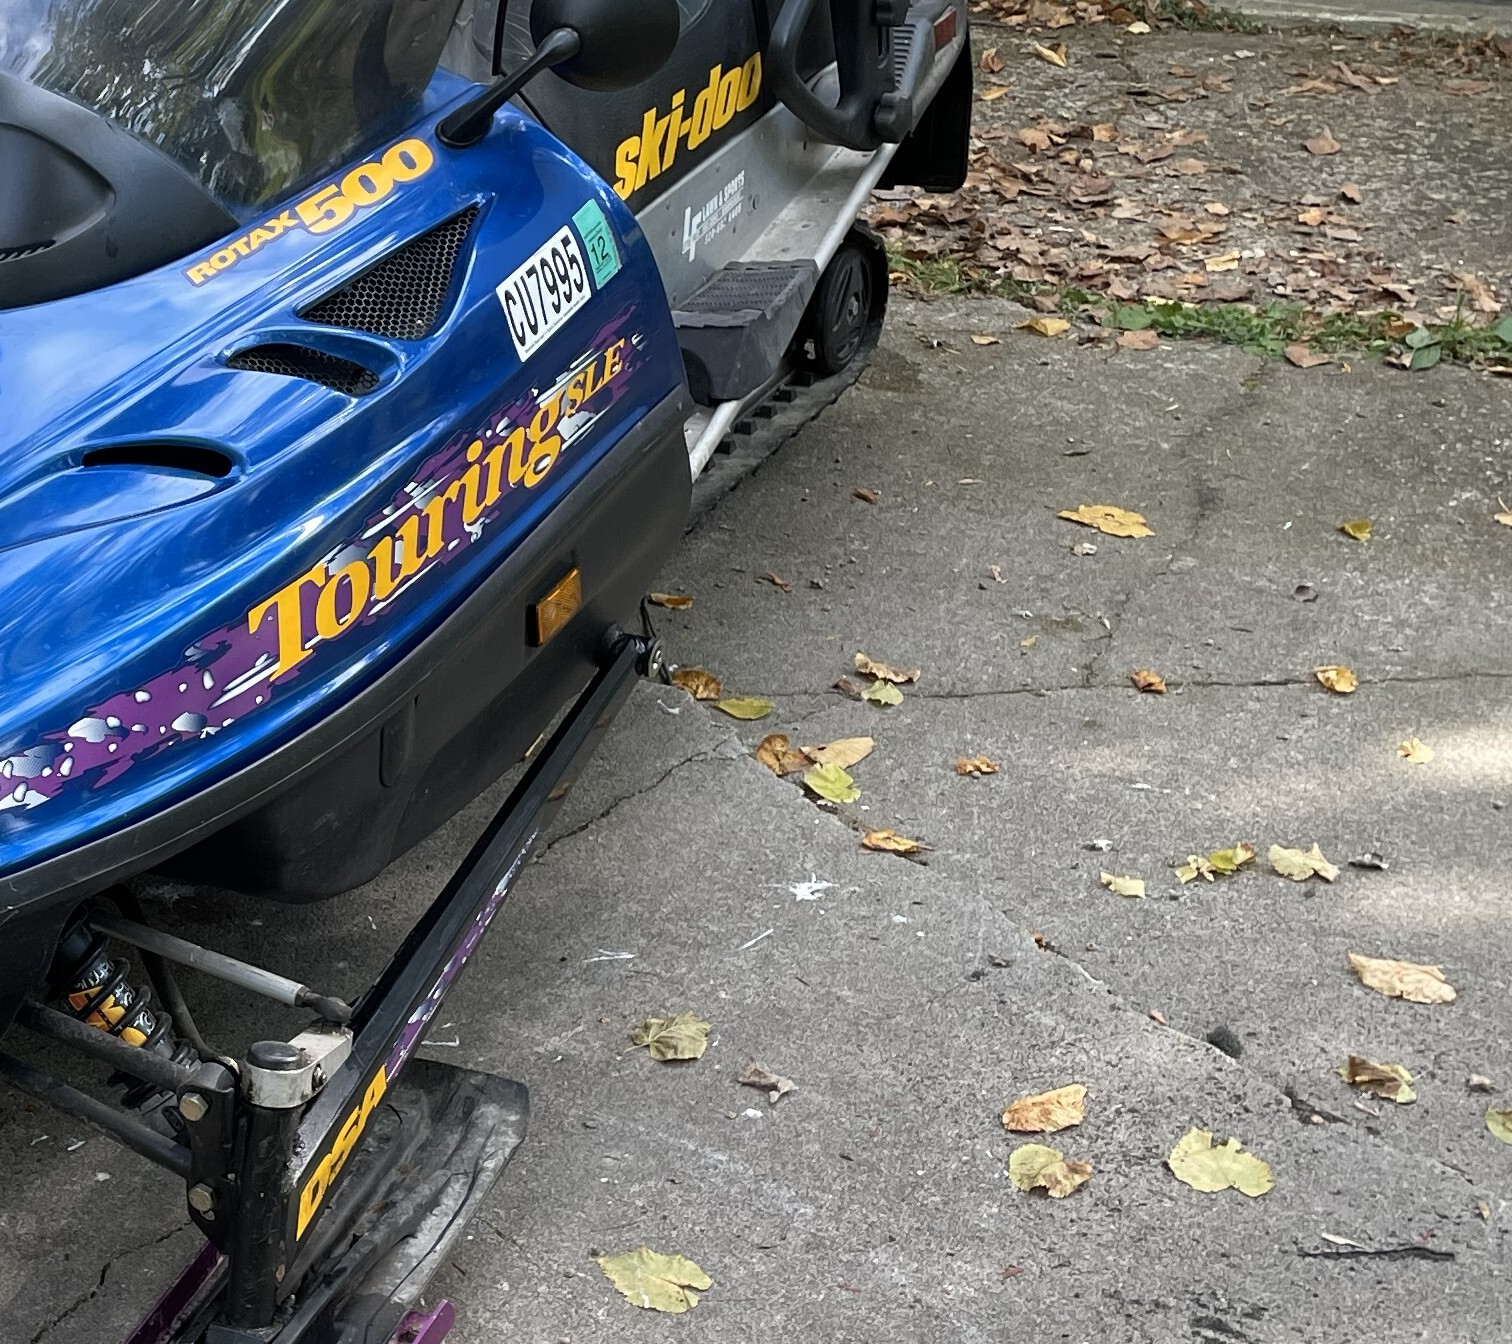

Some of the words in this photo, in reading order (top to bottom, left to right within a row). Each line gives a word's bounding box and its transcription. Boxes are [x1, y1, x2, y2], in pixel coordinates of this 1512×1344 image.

[612, 51, 762, 201] ski-doo
[186, 209, 300, 285] ROTAX
[295, 138, 434, 234] 500
[590, 235, 610, 266] 12
[504, 233, 584, 348] CU7995
[247, 397, 563, 682] Touring
[565, 338, 626, 416] SLE
